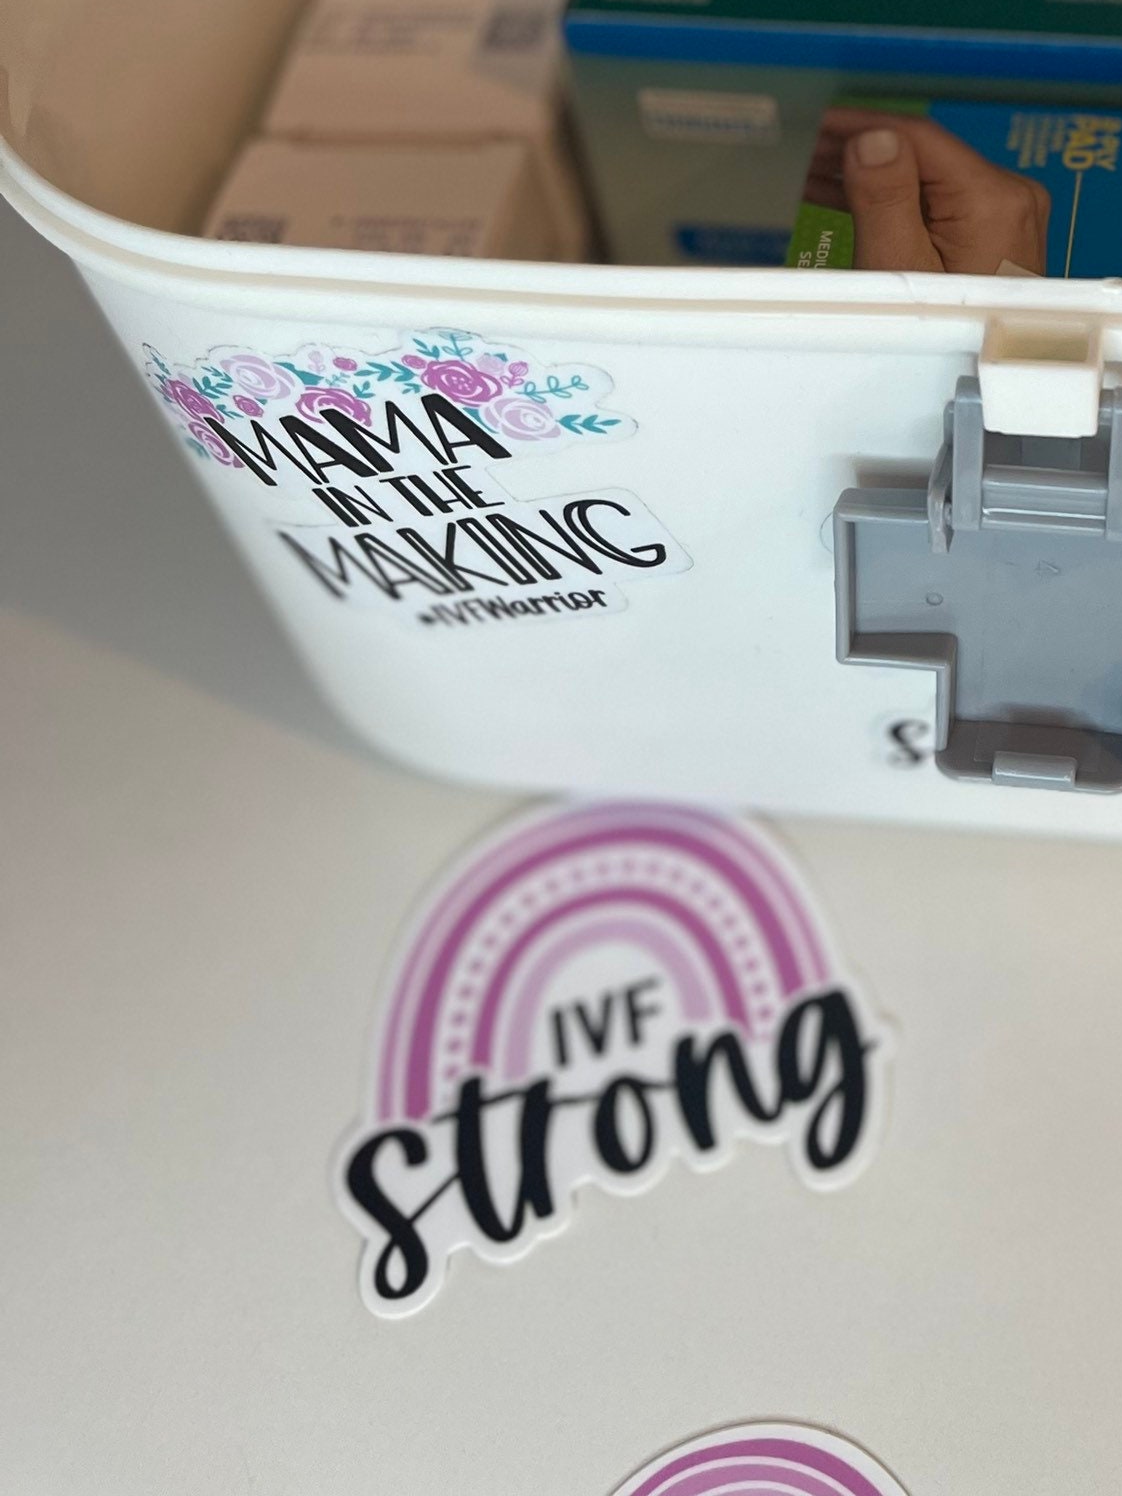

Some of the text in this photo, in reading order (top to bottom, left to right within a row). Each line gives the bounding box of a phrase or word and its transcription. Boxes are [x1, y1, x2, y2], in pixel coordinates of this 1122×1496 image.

[797, 251, 812, 269] SE
[205, 393, 512, 486] MAMA
[312, 466, 505, 528] IN THE
[279, 499, 667, 601] MAKING
[551, 977, 662, 1068] IVF
[346, 990, 878, 1300] strong
